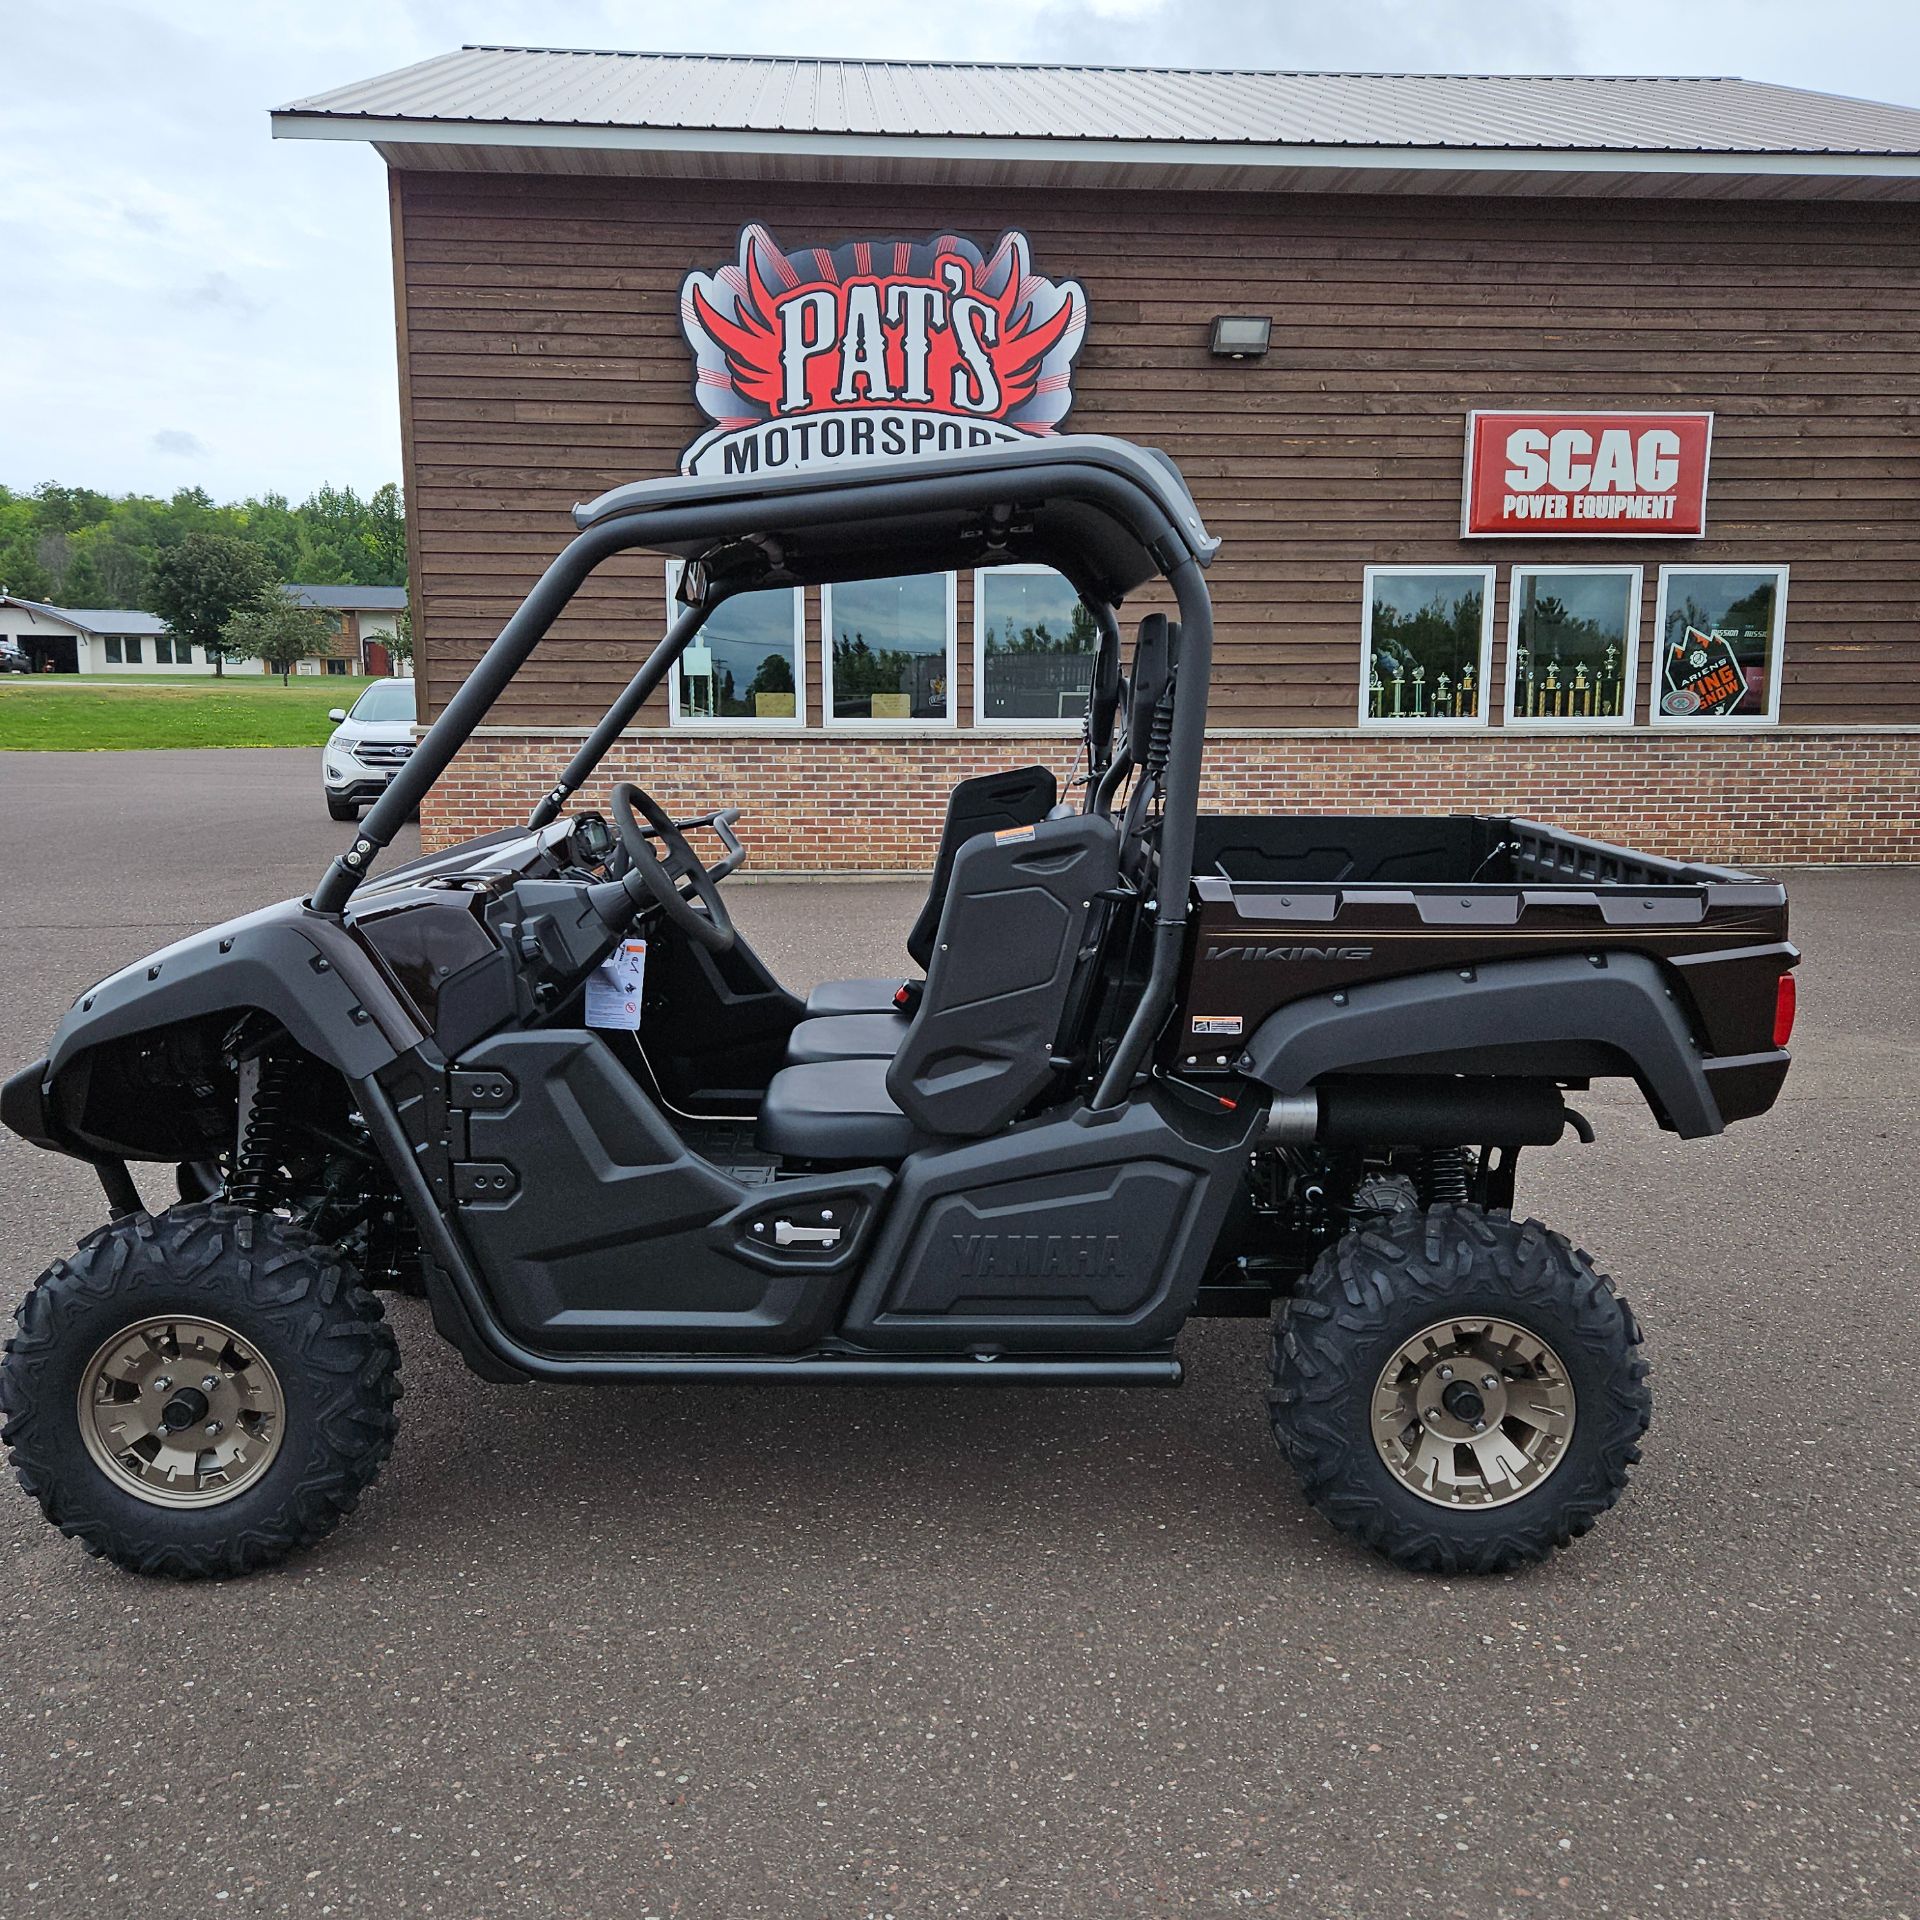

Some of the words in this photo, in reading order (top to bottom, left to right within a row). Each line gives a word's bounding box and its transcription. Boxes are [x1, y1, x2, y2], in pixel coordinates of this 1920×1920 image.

[779, 263, 1000, 412] PAT'S
[1505, 429, 1680, 492] SCAG
[1503, 494, 1568, 519] POWER
[1573, 495, 1677, 519] EQUIPMENT
[1681, 658, 1727, 687] ARIENS
[1699, 679, 1738, 710] SNOW
[1204, 947, 1373, 960] VIKING
[952, 1234, 1127, 1277] YAMAHA
